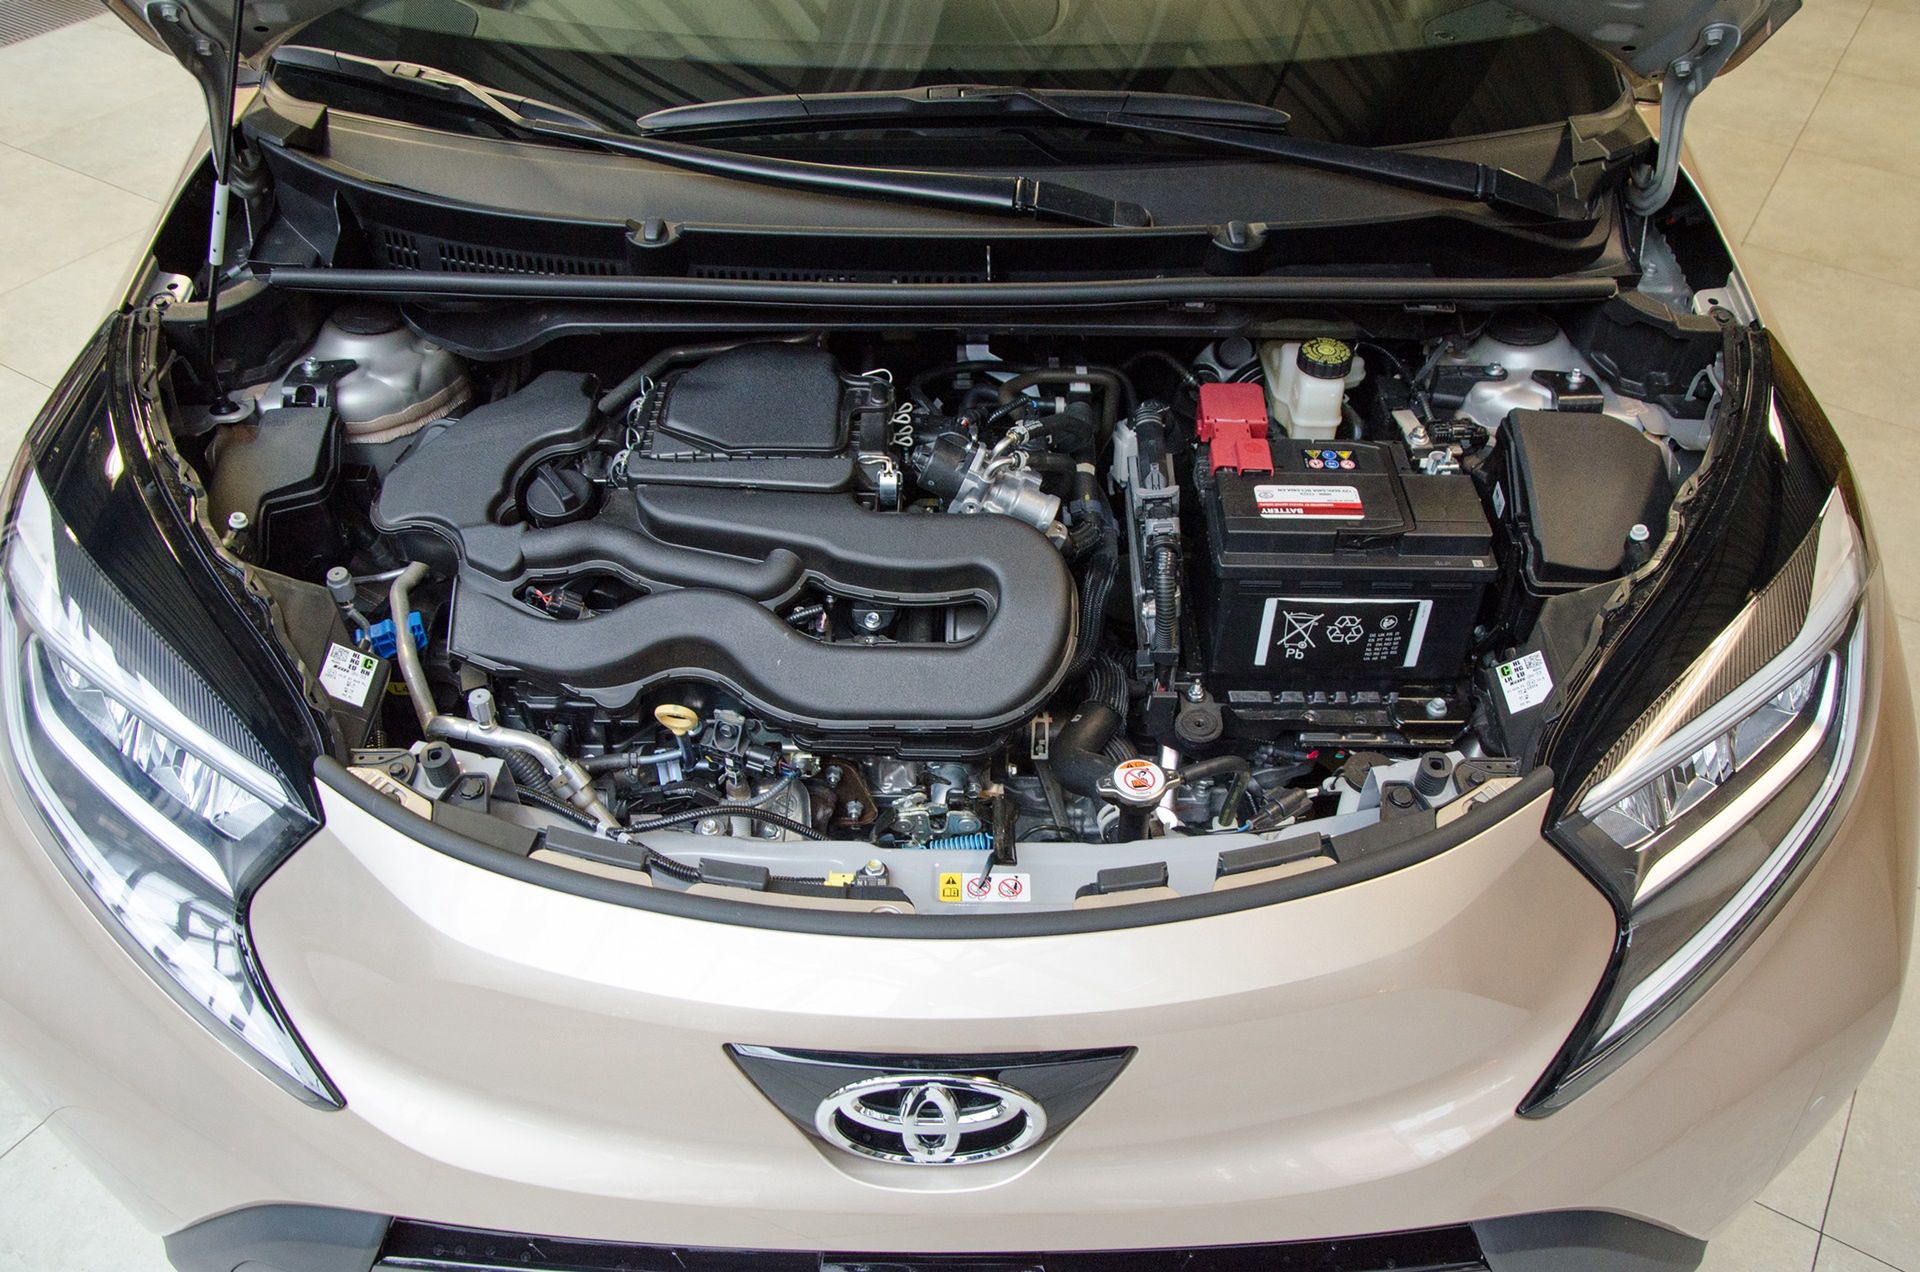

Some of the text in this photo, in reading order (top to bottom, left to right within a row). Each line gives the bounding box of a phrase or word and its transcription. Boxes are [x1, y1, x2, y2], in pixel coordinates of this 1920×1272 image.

[1285, 648, 1304, 660] Pb
[364, 658, 373, 669] C
[1501, 665, 1511, 676] C
